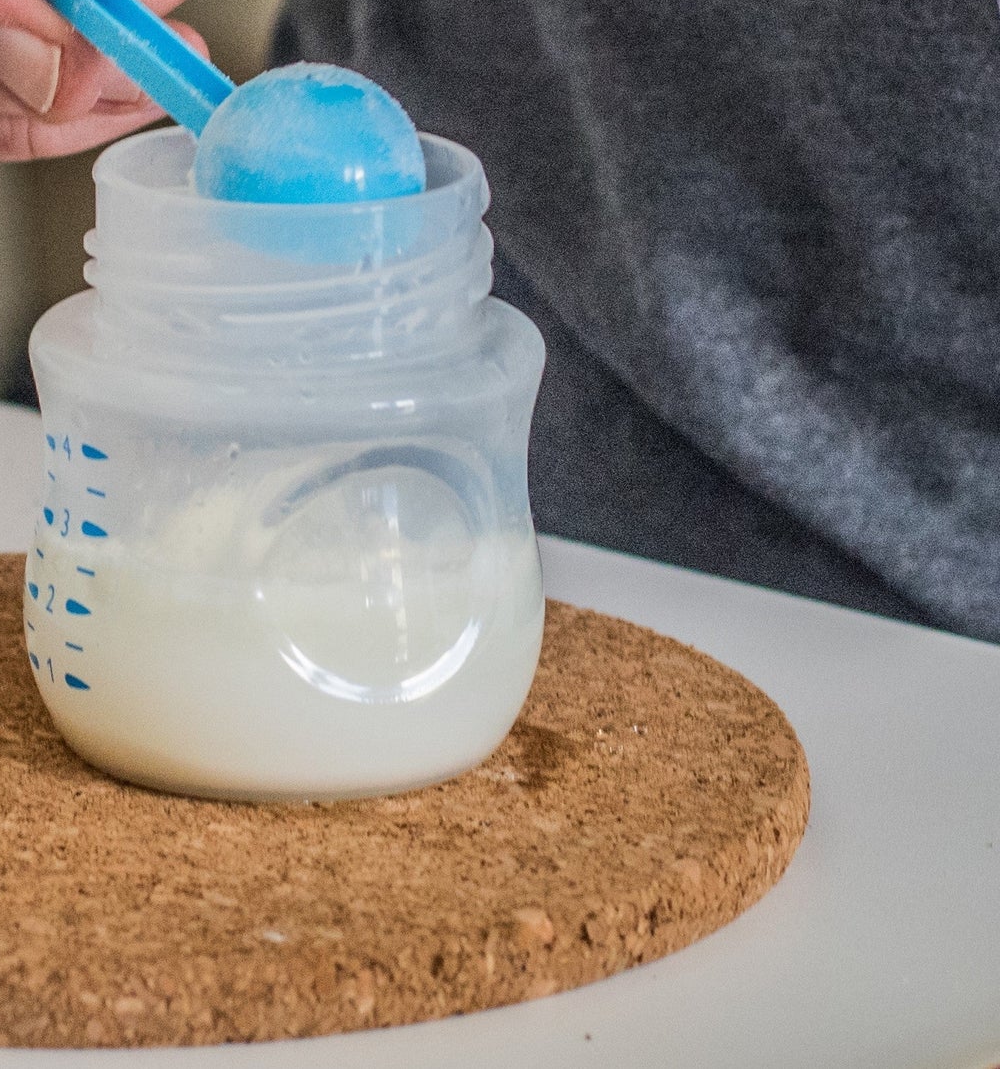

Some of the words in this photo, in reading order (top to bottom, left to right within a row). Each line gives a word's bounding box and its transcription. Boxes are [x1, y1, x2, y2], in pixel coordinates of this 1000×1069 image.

[63, 434, 71, 461] 4
[60, 508, 70, 537] 3
[46, 584, 55, 613] 2
[47, 658, 55, 683] 1
